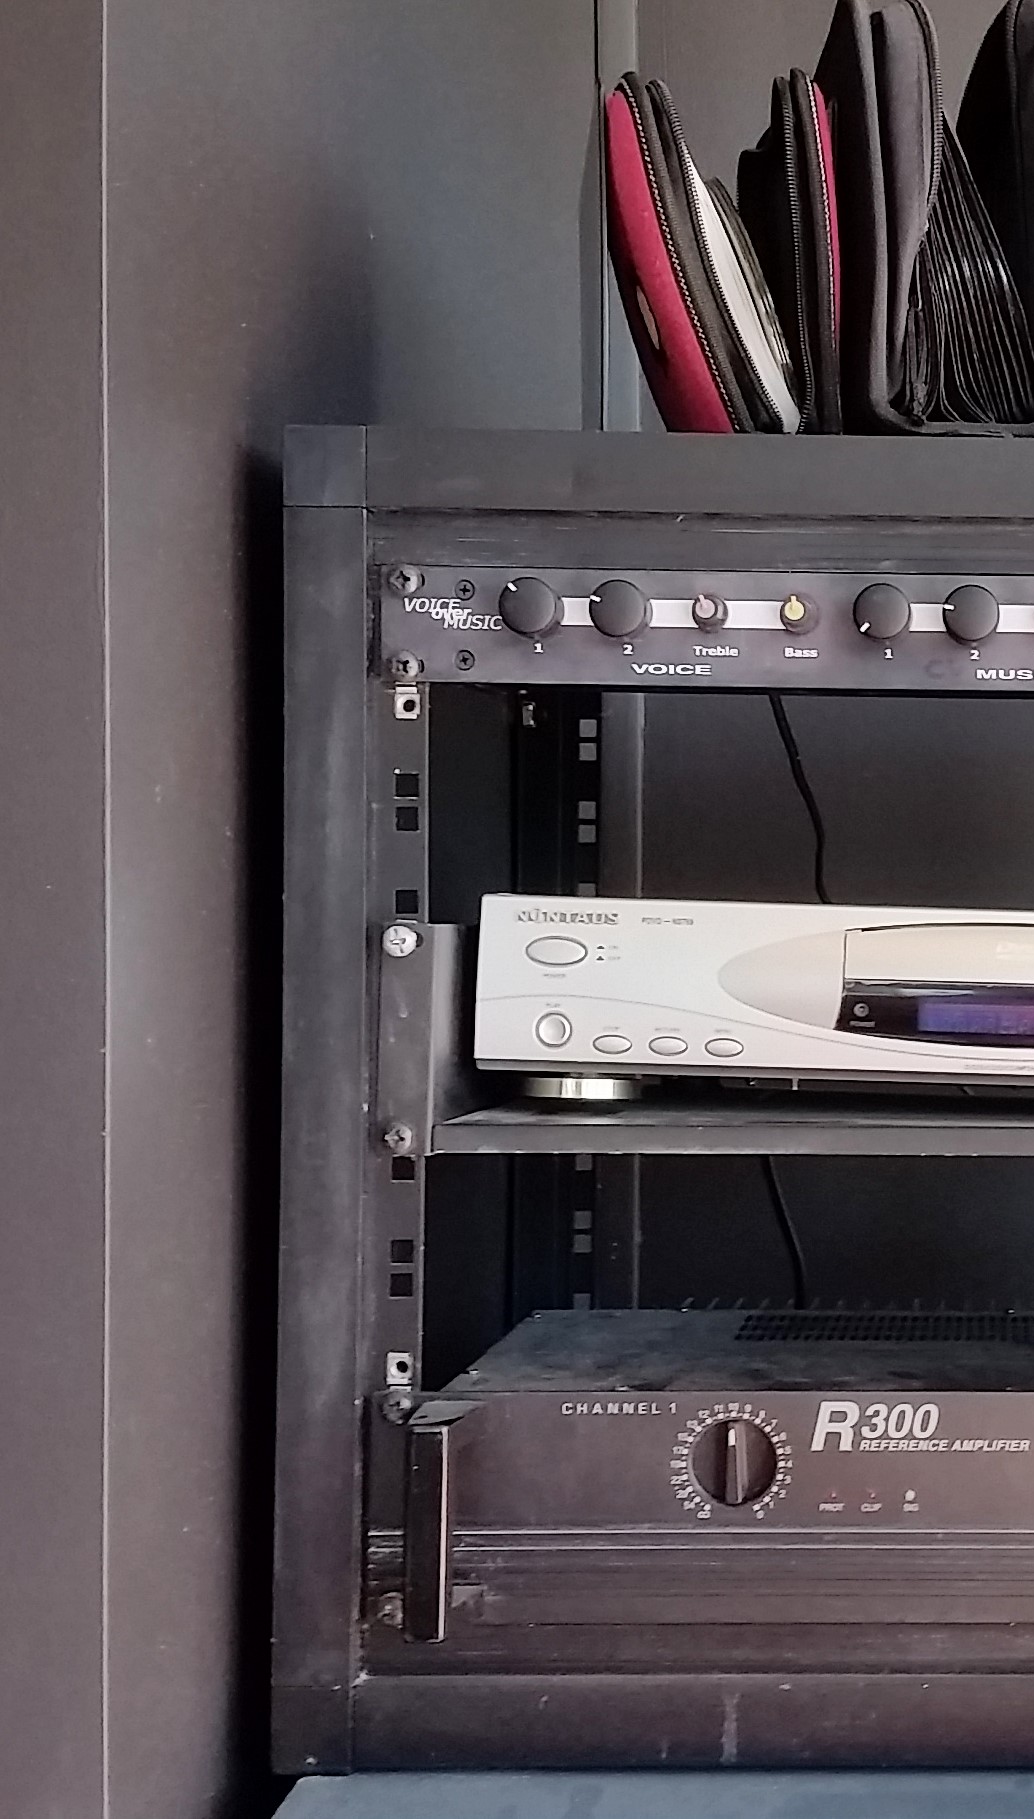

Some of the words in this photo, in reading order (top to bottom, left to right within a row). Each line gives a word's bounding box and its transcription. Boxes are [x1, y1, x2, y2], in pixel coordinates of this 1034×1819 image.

[403, 597, 461, 613] VOICE
[442, 614, 503, 630] MUSIC
[534, 643, 544, 654] 1
[622, 644, 634, 656] 2
[693, 645, 739, 657] Treble
[784, 647, 819, 658] Bass
[883, 649, 894, 660] 1
[969, 650, 981, 661] 2
[631, 663, 712, 675] VOICE
[561, 1402, 662, 1415] CHANNEL
[668, 1402, 677, 1414] 1
[859, 1439, 949, 1451] REFERENCE
[950, 1439, 1031, 1451] AMPLIFIER
